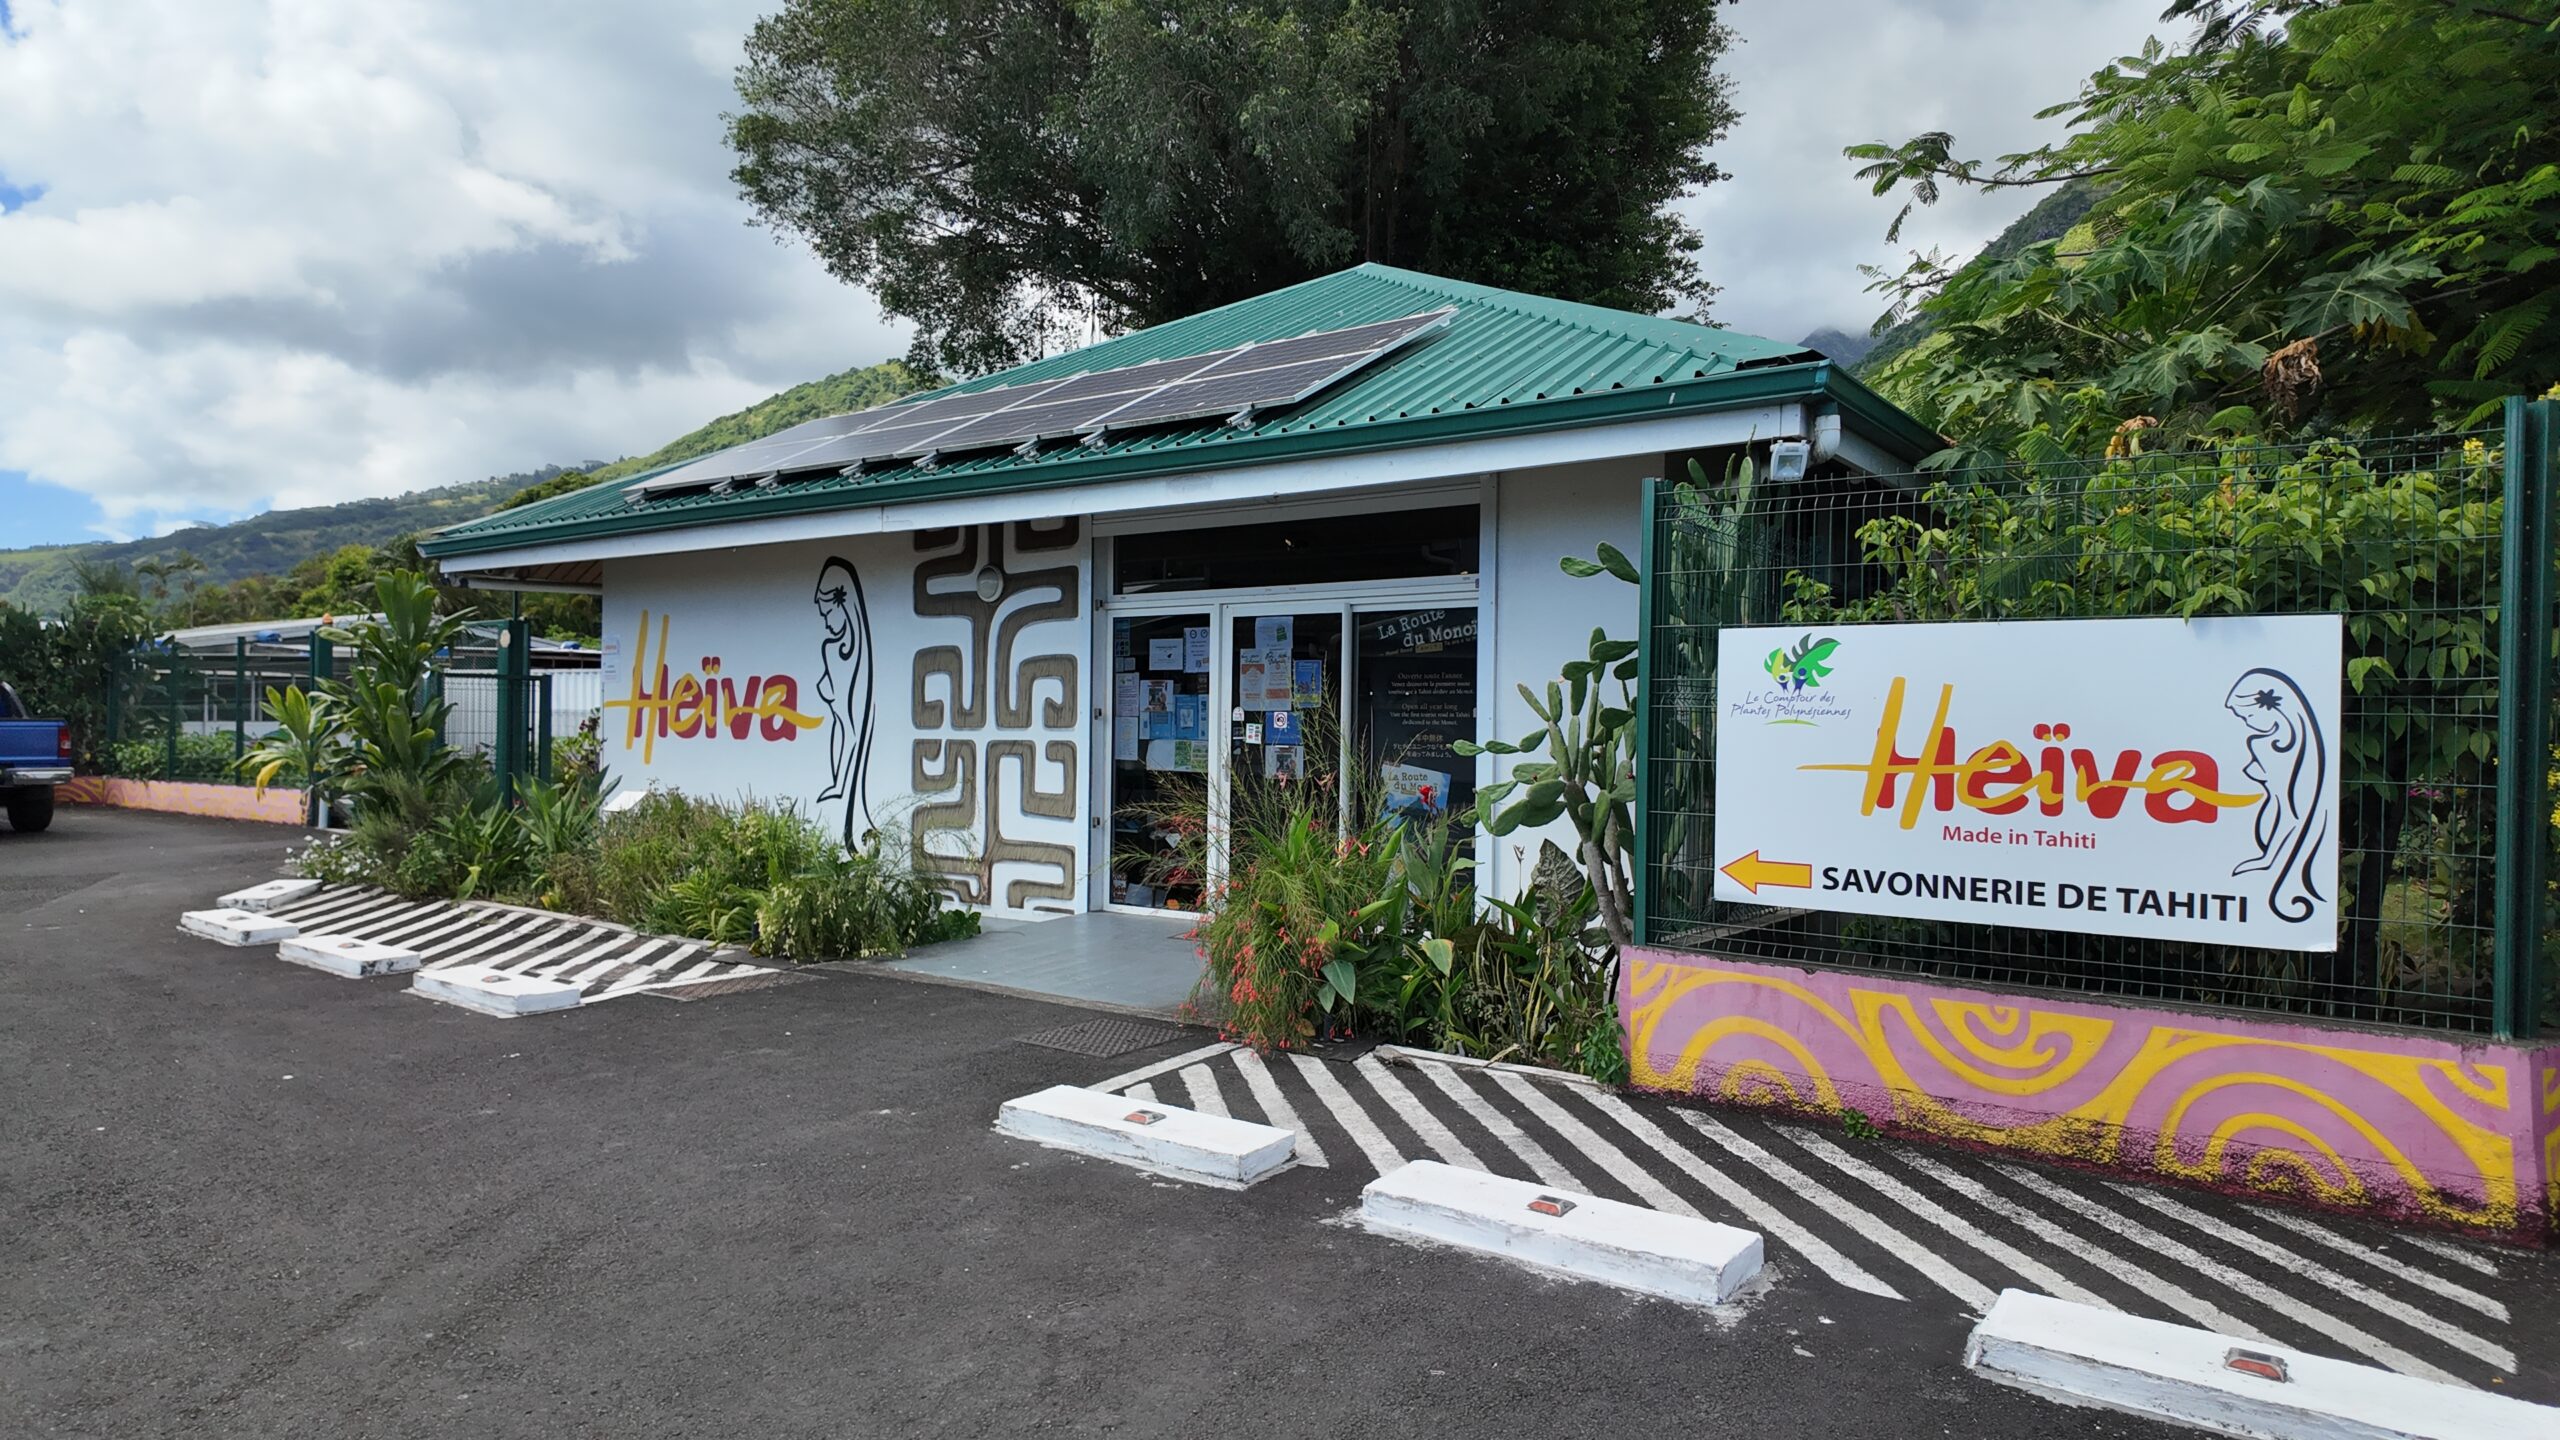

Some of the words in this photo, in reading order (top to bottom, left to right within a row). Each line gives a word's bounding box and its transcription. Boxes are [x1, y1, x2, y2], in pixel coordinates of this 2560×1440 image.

[1378, 624, 1397, 640] La
[1399, 609, 1446, 632] Route
[1403, 632, 1425, 648] du
[1427, 620, 1477, 643] Monoï
[604, 609, 824, 764] Heïva
[1745, 690, 1760, 705] Le
[1764, 690, 1817, 708] Comptoir
[1820, 690, 1836, 706] des
[1731, 703, 1771, 719] Plantes
[1775, 703, 1852, 722] Polynésiennes
[1796, 676, 2265, 830] Heïva
[1394, 782, 1407, 790] du
[1401, 772, 1428, 781] Route
[1942, 825, 2003, 843] Made
[2008, 828, 2028, 845] in
[2034, 830, 2097, 849] Tahiti
[1822, 866, 2046, 907] SAVONNERIE
[2057, 883, 2107, 912] DE
[2116, 887, 2248, 923] TAHITI
